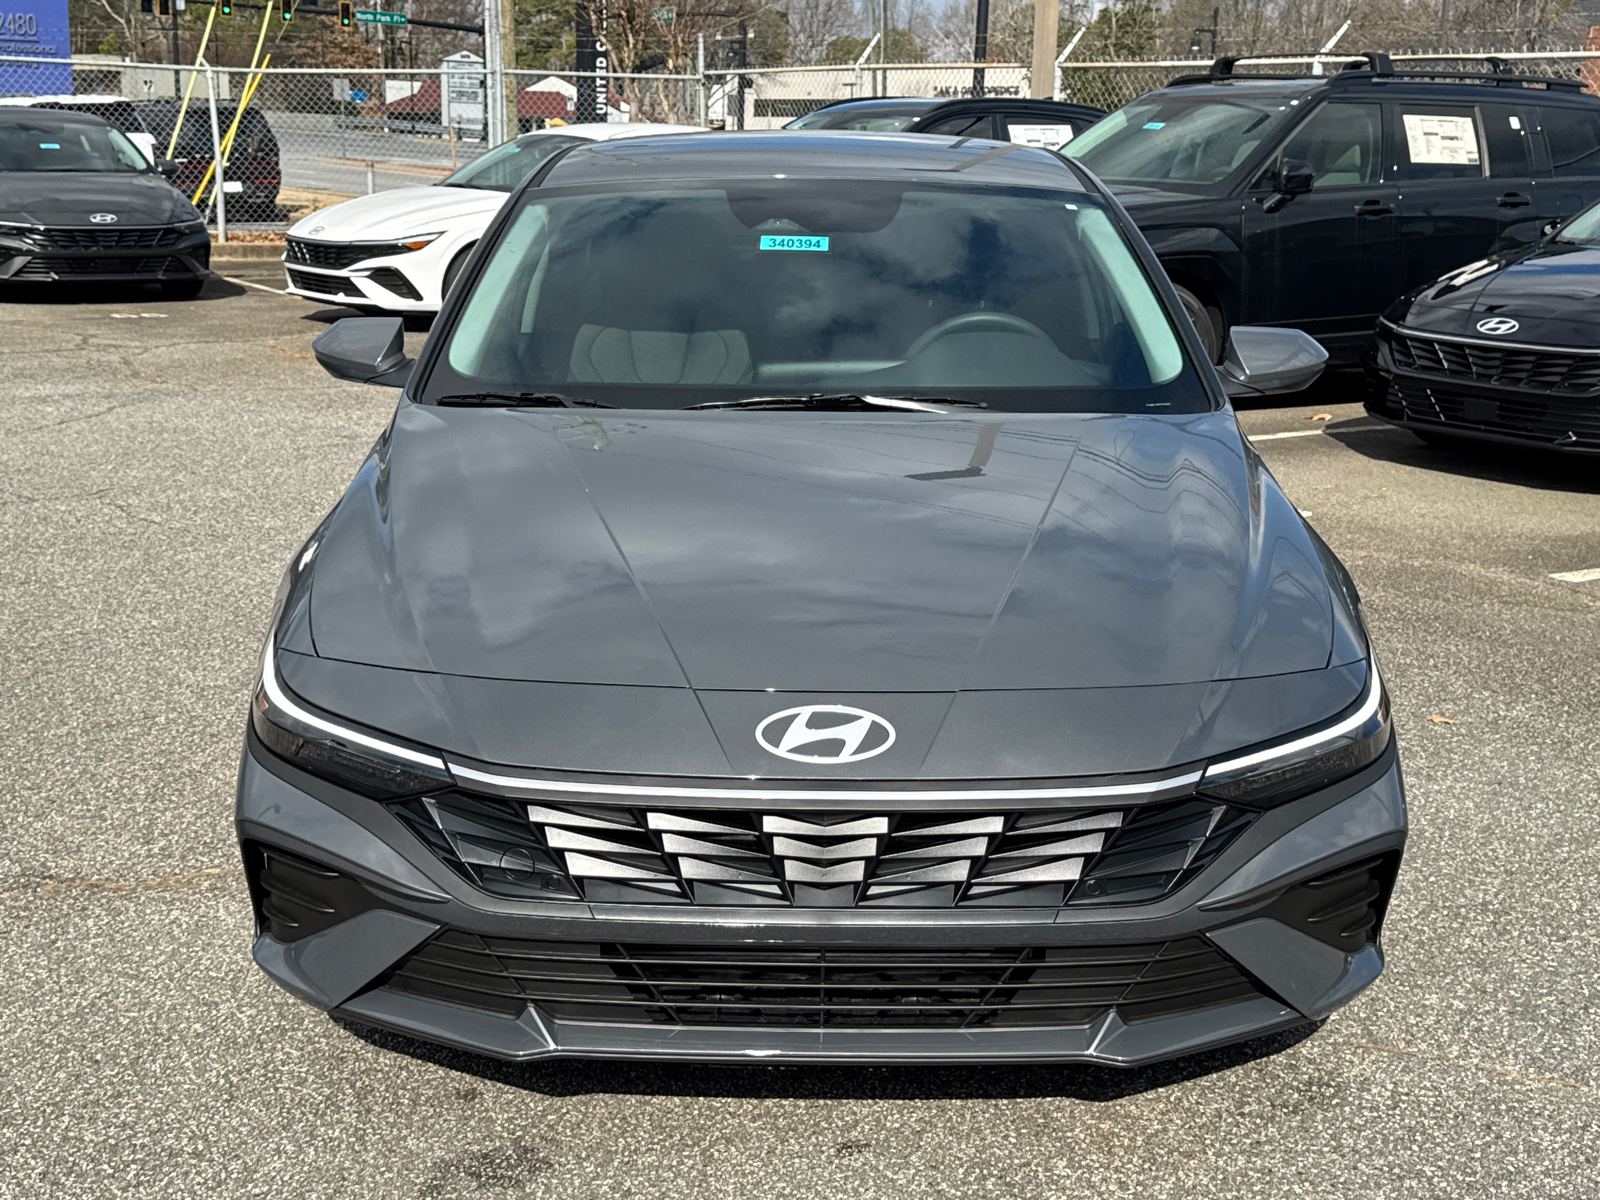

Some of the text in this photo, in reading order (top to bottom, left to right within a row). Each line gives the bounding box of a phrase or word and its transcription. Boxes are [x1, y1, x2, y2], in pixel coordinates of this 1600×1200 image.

[0, 43, 57, 55] rofessional
[596, 57, 607, 114] UNITED
[768, 238, 822, 249] 340394
